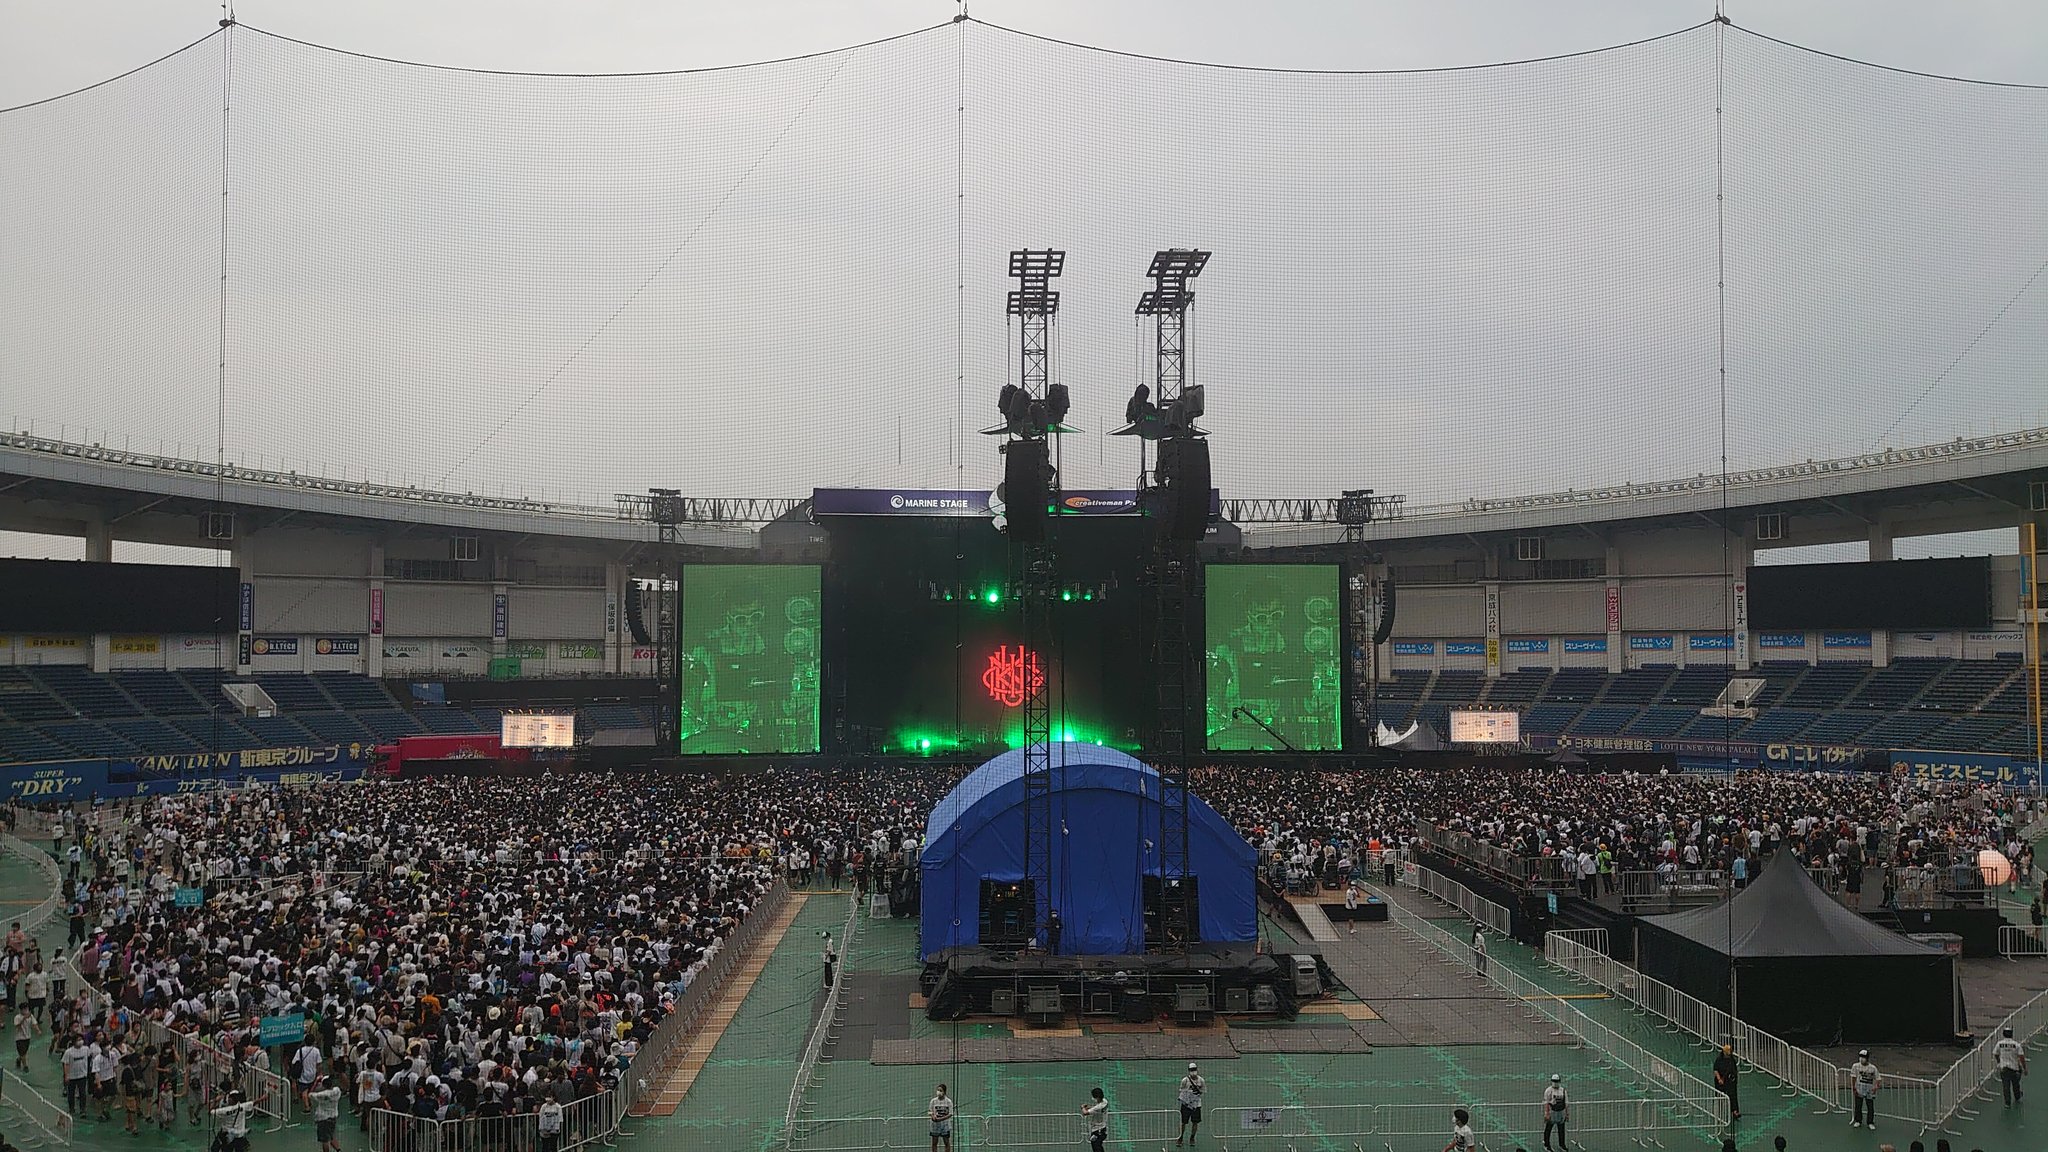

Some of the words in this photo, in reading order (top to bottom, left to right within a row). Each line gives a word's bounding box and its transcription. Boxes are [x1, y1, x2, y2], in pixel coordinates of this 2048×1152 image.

[905, 499, 938, 508] MARINE
[940, 499, 969, 508] STAGE
[1660, 742, 1685, 752] LOTTE
[1686, 743, 1704, 753] NEW
[1706, 744, 1728, 754] YORK
[1729, 745, 1759, 756] PALACE
[240, 744, 340, 768] 新東京グループ
[34, 769, 65, 779] SUPER
